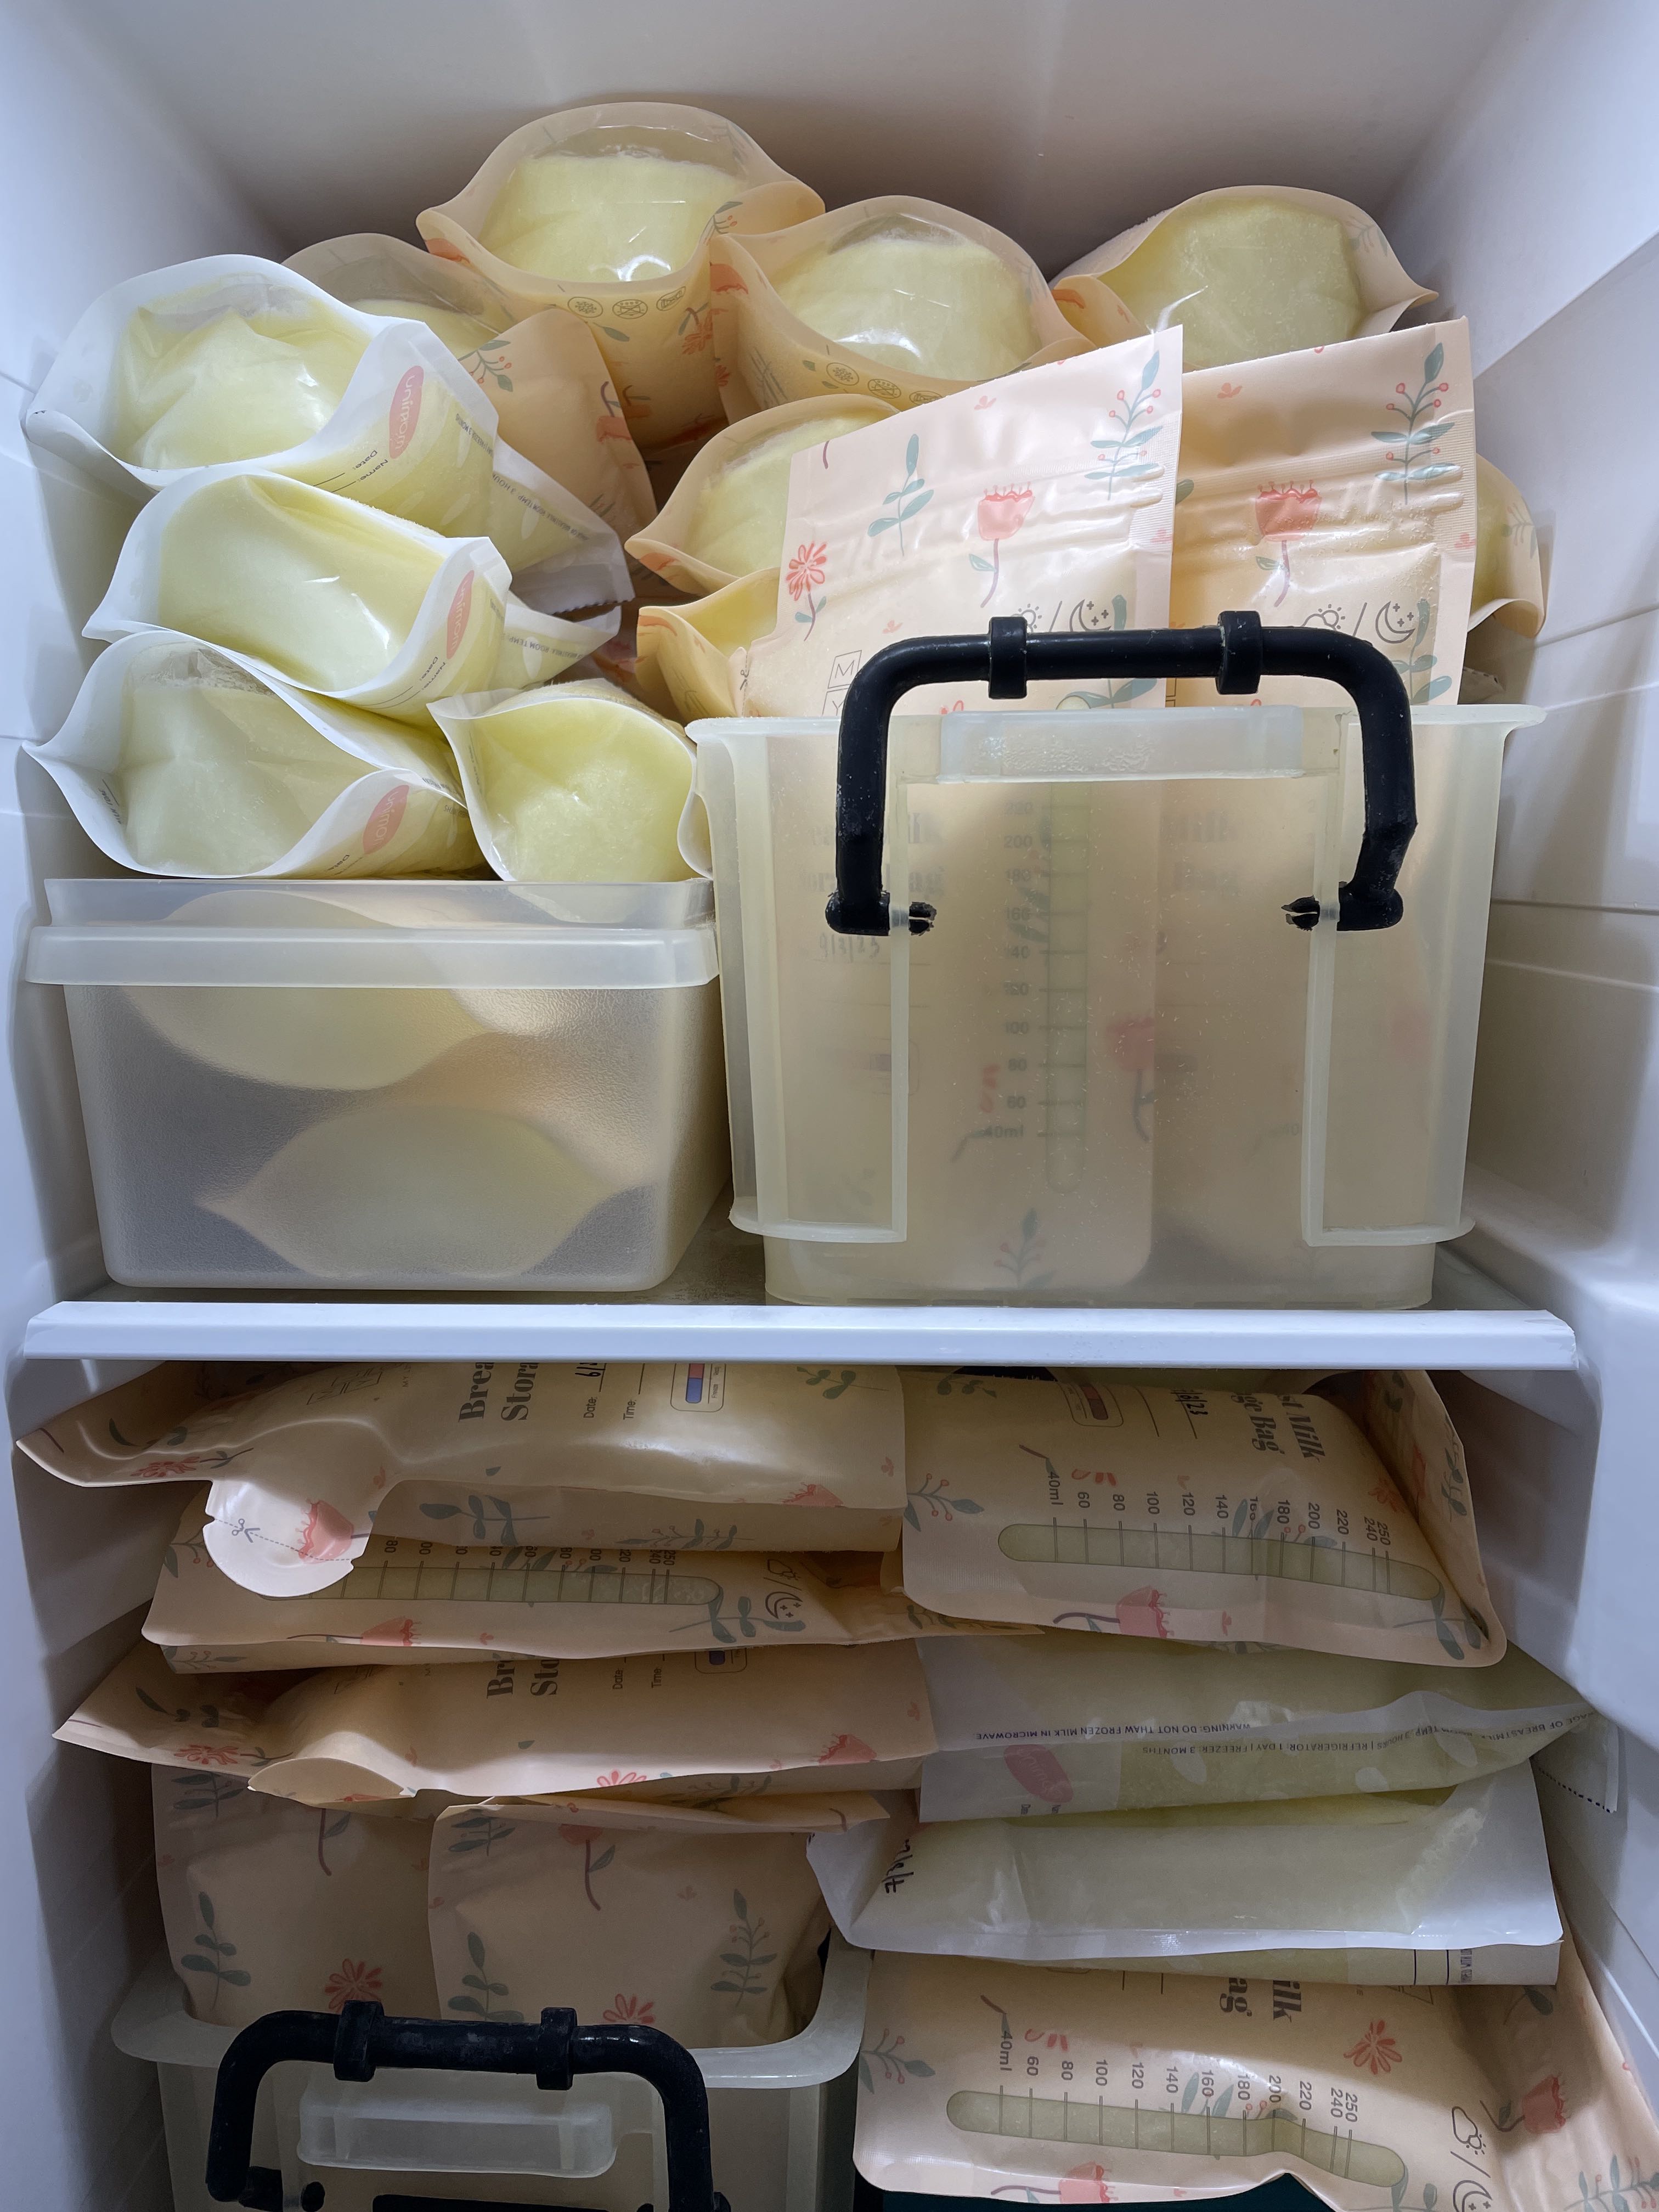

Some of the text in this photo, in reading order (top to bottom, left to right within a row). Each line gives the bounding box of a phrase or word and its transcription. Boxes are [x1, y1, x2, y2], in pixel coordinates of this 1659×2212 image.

[358, 459, 388, 482] Name:
[1003, 835, 1033, 849] 200
[1285, 1412, 1325, 1463] Milk
[1047, 1471, 1064, 1506] 40ml
[1077, 1491, 1091, 1509] 60
[1111, 1493, 1126, 1512] 80
[1147, 1491, 1160, 1516] 100
[1182, 1492, 1196, 1517] 120
[1215, 1494, 1229, 1519] 140
[1276, 1499, 1291, 1525] 180
[1307, 1501, 1321, 1530] 200
[1336, 1509, 1350, 1535] 220
[1363, 1516, 1379, 1542] 240
[1376, 1521, 1391, 1546] 250
[1040, 1729, 1051, 1737] IN
[1054, 1727, 1077, 1736] MILK
[1080, 1726, 1121, 1735] FROZEN
[1125, 1726, 1154, 1735] THAW
[1158, 1726, 1180, 1734] NOT
[1182, 1725, 1198, 1734] DO
[1549, 1720, 1564, 1731] OF
[1142, 1746, 1187, 1755] MONTHS
[1256, 1743, 1276, 1751] DAY
[1000, 2030, 1013, 2072] 40ml
[1026, 2055, 1040, 2076] 60
[1061, 2060, 1074, 2081] 80
[1096, 2059, 1109, 2086] 100
[1131, 2062, 1144, 2090] 120
[1166, 2065, 1179, 2094] 140
[1201, 2069, 1215, 2097] 160
[1237, 2073, 1251, 2101] 180
[1268, 2074, 1282, 2103] 200
[1299, 2080, 1312, 2111] 220
[1330, 2087, 1343, 2119] 240
[1345, 2091, 1358, 2123] 250
